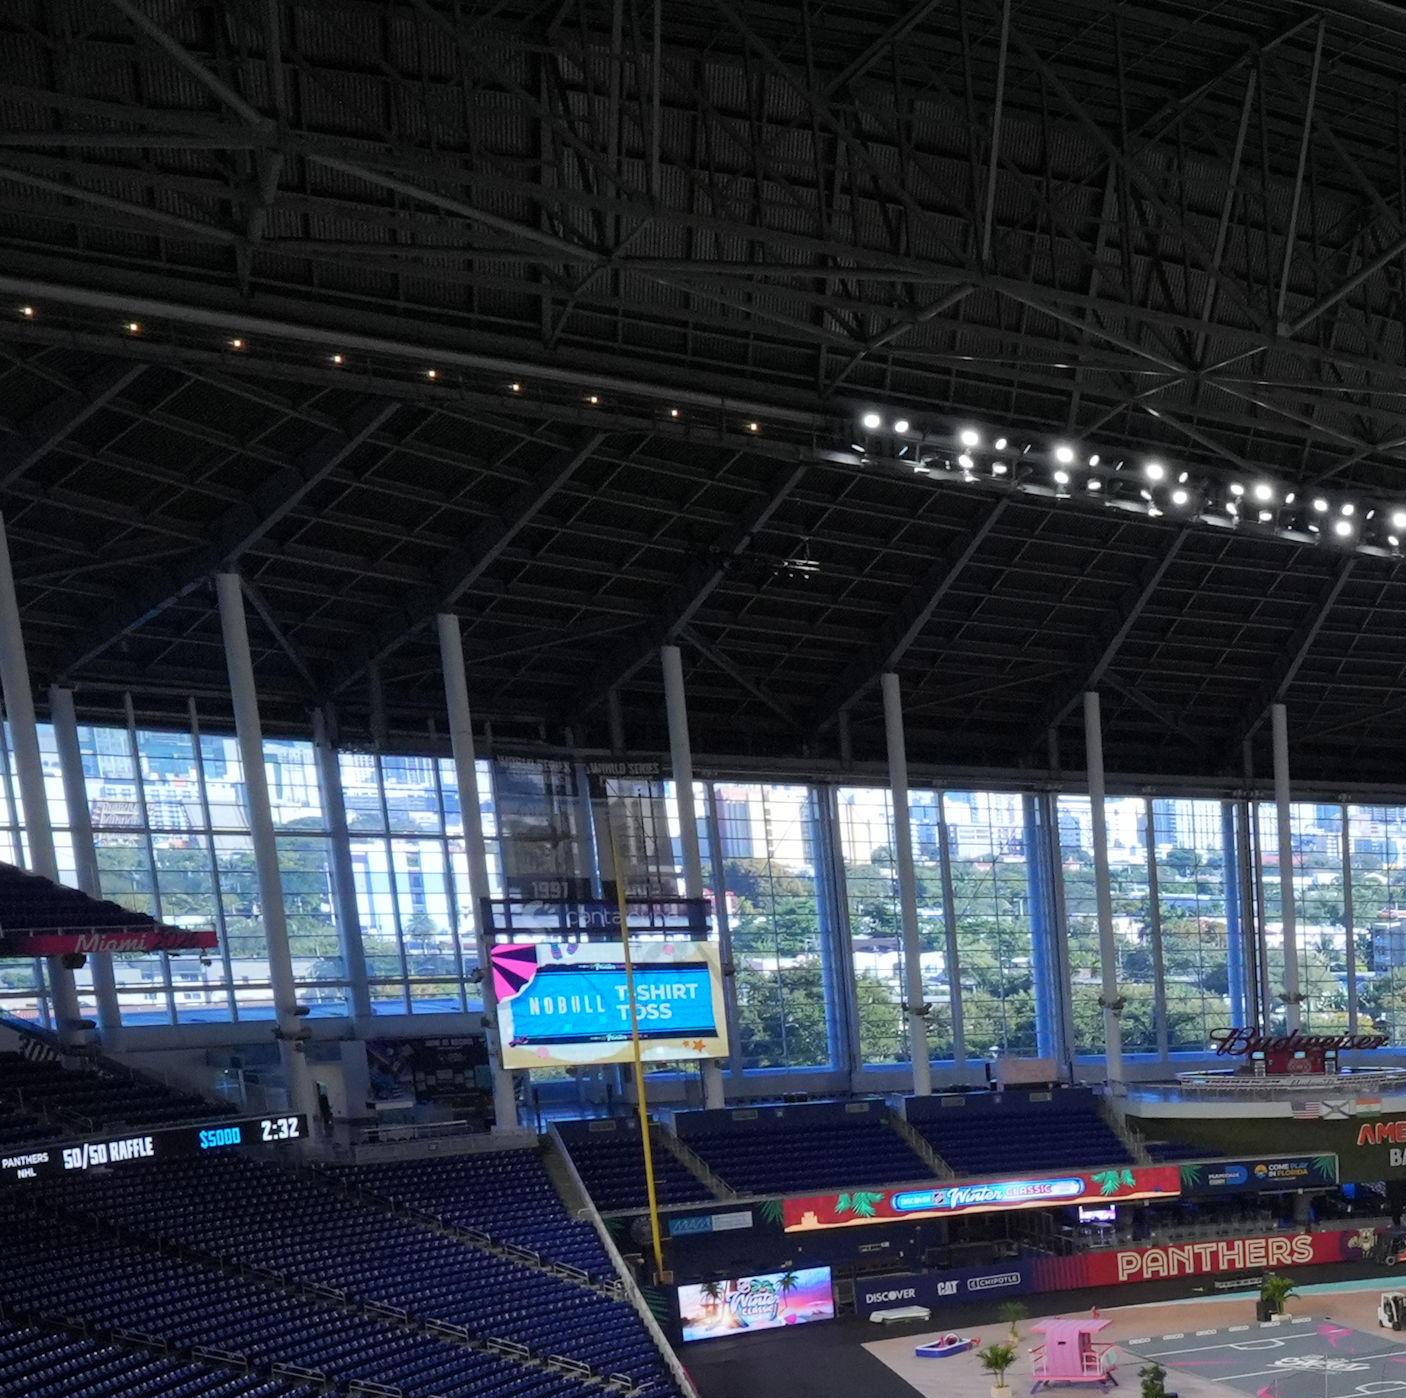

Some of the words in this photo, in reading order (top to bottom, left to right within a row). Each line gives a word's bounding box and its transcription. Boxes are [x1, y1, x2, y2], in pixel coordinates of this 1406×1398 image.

[531, 881, 569, 899] 1991
[74, 933, 148, 952] Miami
[529, 994, 606, 1016] NOBULL
[616, 1003, 673, 1021] TOSS
[1209, 1026, 1390, 1057] Budweiser
[199, 1126, 242, 1150] $5000
[260, 1116, 300, 1142] 2:32
[1, 1151, 49, 1169] PANTHERS
[62, 1142, 109, 1170] 50/50
[108, 1136, 155, 1163] RAFFLE
[17, 1167, 37, 1179] NHL
[1268, 1163, 1290, 1171] COME
[1268, 1170, 1277, 1178] IN
[1276, 1168, 1309, 1177] FLORIDA
[946, 1185, 1003, 1210] Winter
[1004, 1183, 1052, 1197] CLASSIC
[1116, 1234, 1314, 1282] PANTHERS
[936, 1280, 959, 1296] CAT
[978, 1274, 1018, 1288] CHIPOTLE
[866, 1287, 917, 1304] DISCOVER
